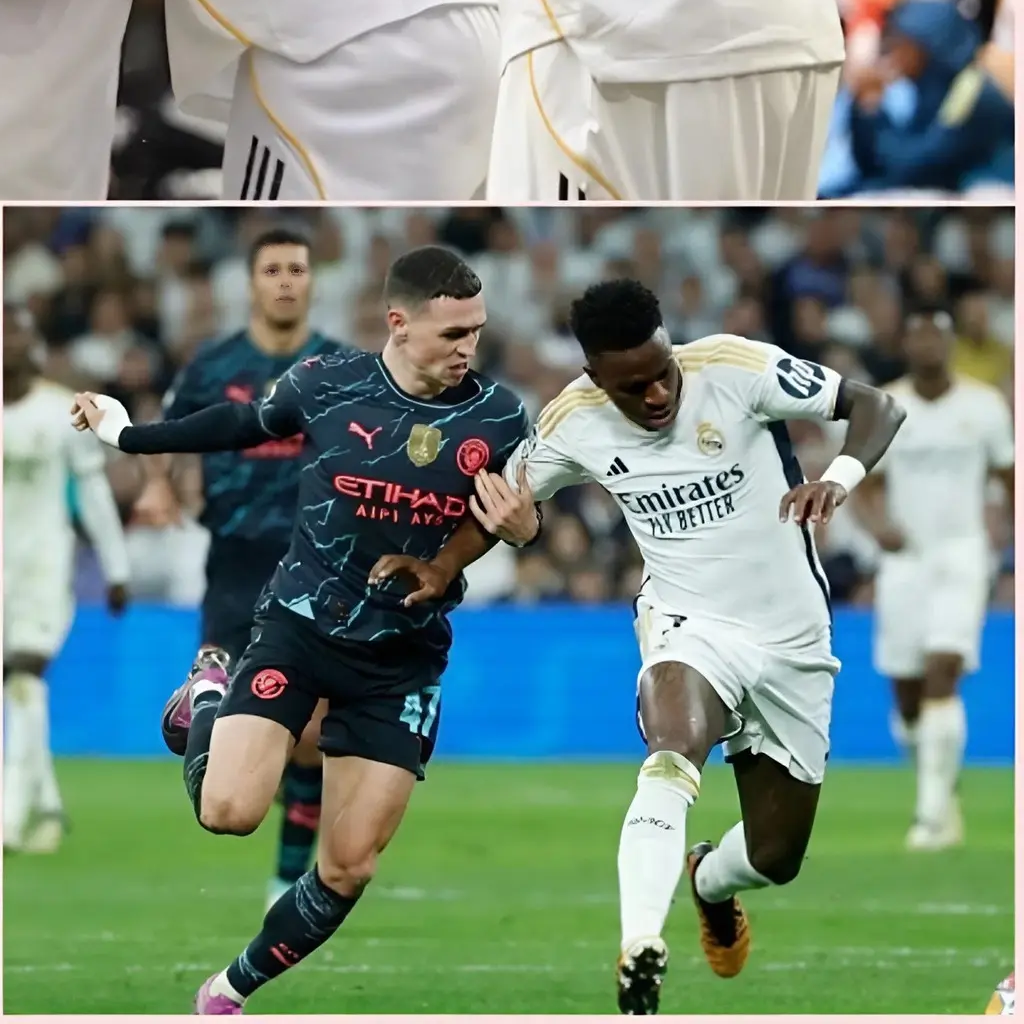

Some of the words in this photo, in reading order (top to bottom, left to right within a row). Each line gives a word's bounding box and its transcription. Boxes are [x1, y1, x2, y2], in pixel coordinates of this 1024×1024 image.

[776, 358, 826, 399] hp
[333, 475, 466, 517] ETIHAD
[616, 463, 745, 514] Emirates
[355, 504, 444, 526] AIRAYS
[676, 493, 735, 531] BETTER
[399, 685, 441, 737] 47
